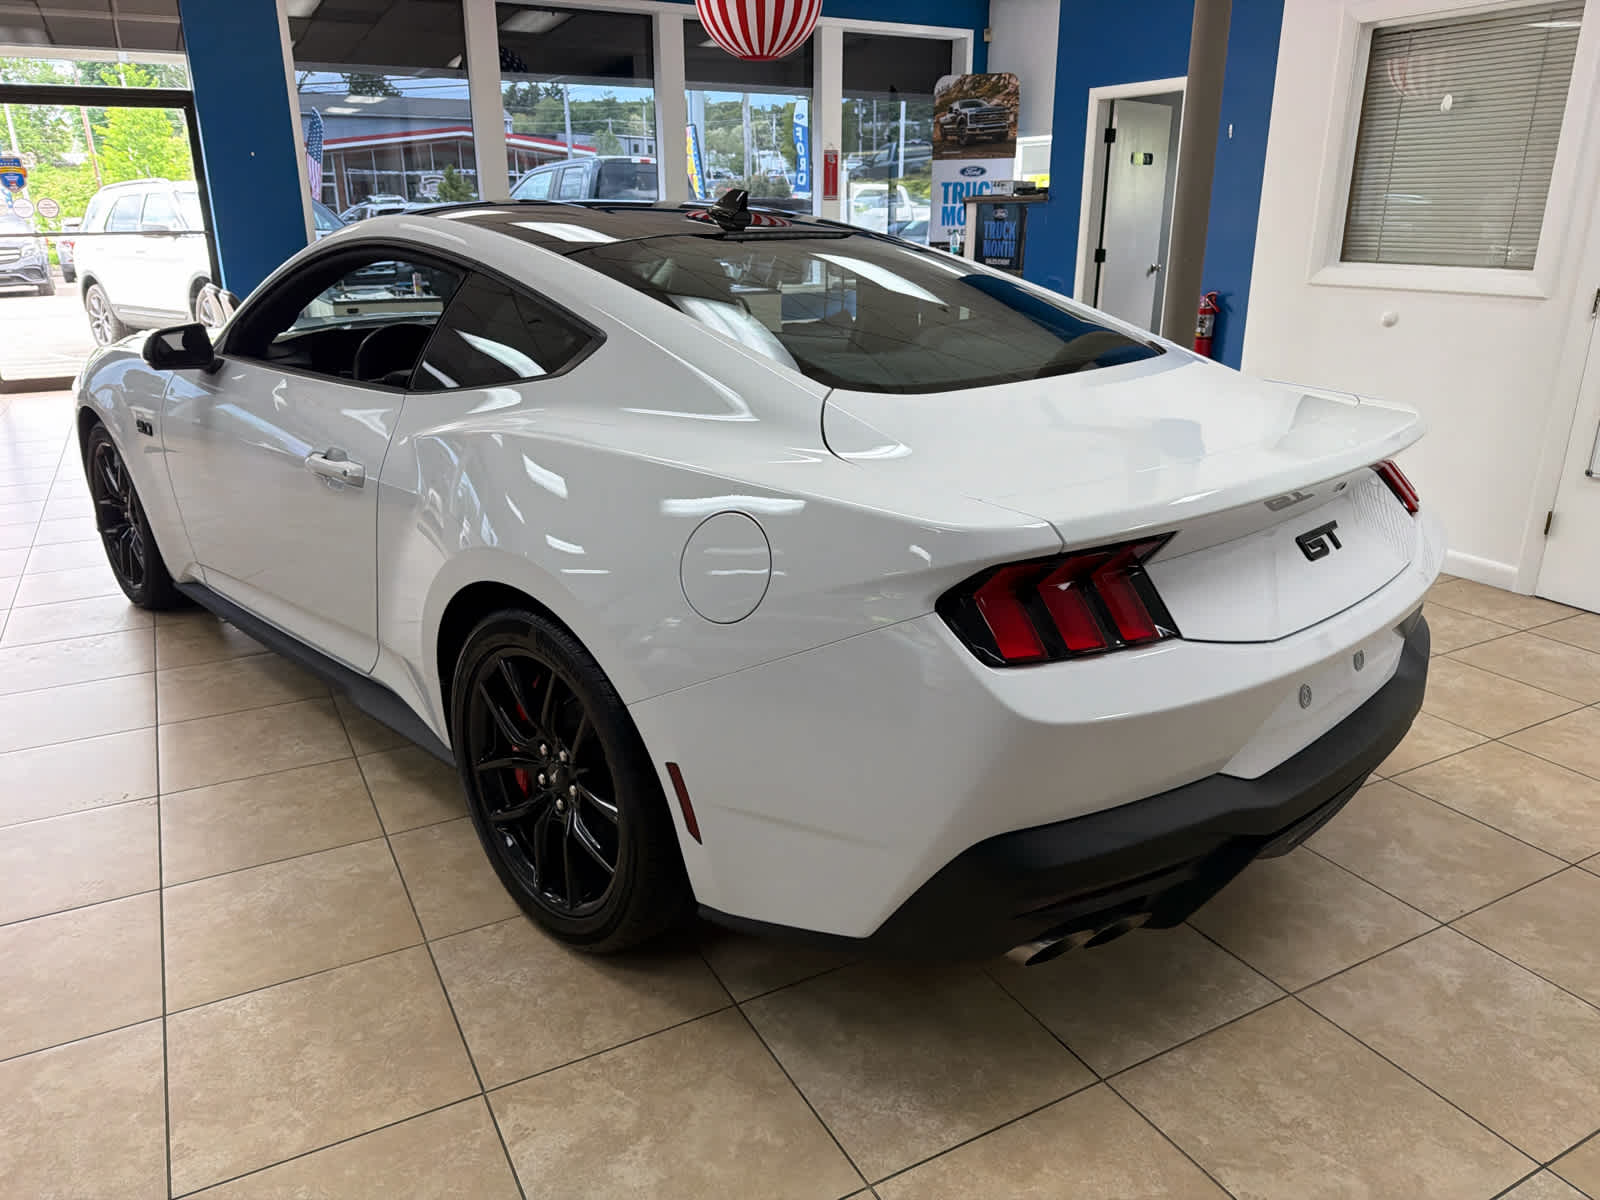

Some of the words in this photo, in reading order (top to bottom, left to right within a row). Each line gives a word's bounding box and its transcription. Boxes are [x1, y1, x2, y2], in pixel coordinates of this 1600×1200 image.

[941, 181, 991, 204] TRUC
[984, 221, 1016, 240] TRUCK
[983, 239, 1015, 257] MONTH
[1295, 519, 1342, 562] GT
